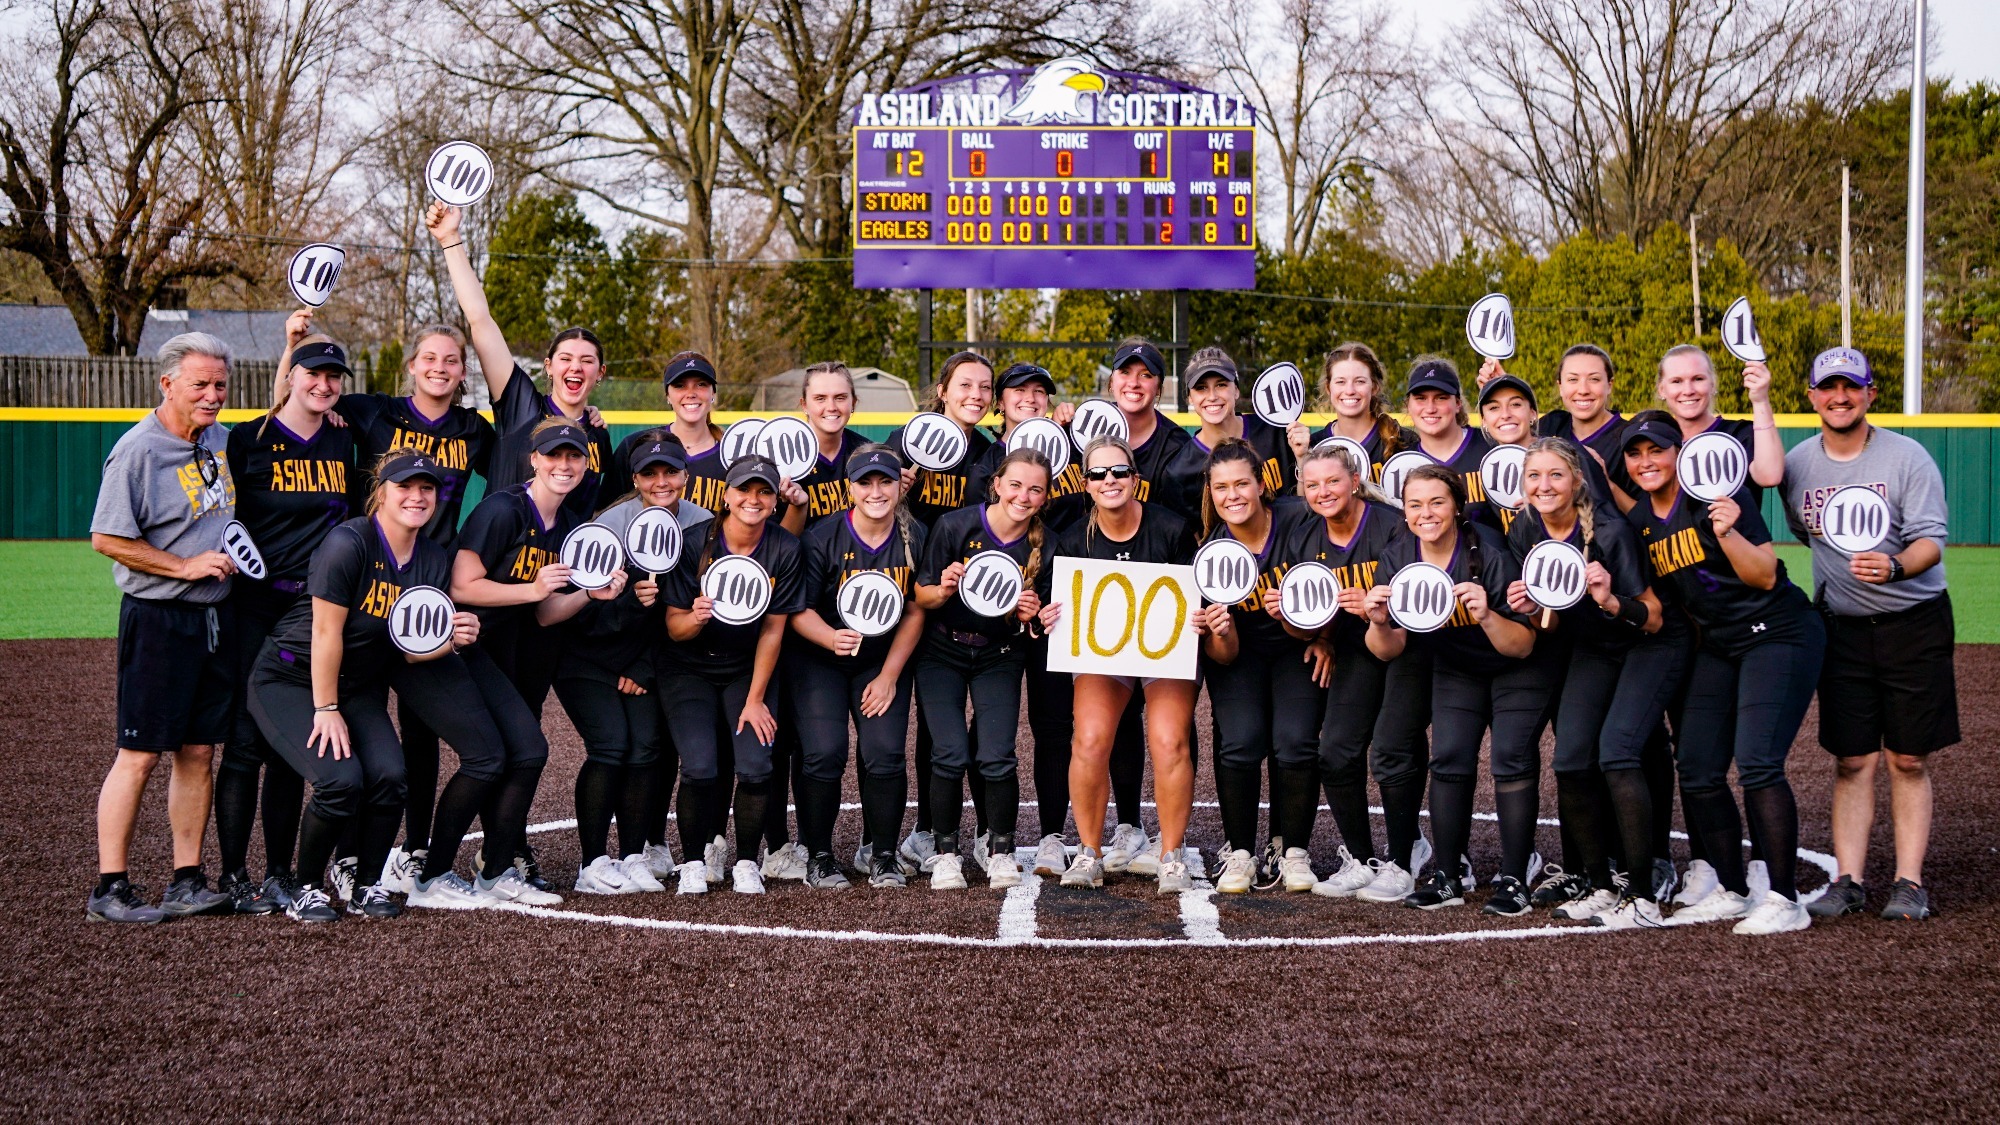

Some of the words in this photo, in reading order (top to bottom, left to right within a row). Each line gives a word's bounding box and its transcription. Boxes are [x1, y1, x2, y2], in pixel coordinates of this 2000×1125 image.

[858, 93, 1000, 126] ASHLAND
[1108, 93, 1251, 126] SOFTBALL
[873, 132, 889, 149] AT
[891, 132, 916, 149] BAT
[961, 132, 994, 149] BALL
[1040, 132, 1089, 149] STRIKE
[1133, 132, 1163, 149] OUT
[1208, 132, 1234, 150] H/E
[433, 154, 486, 197] 100
[896, 151, 924, 176] 12
[969, 151, 986, 177] 0
[1056, 151, 1073, 177] 0
[1212, 152, 1229, 176] H
[865, 192, 926, 211] STORM
[948, 181, 956, 194] 1
[964, 181, 973, 194] 2
[981, 181, 990, 194] 3
[1004, 181, 1013, 194] 4
[1021, 181, 1030, 194] 5
[1037, 181, 1046, 194] 6
[1061, 181, 1070, 194] 7
[1077, 181, 1086, 194] 8
[1094, 181, 1103, 194] 9
[1116, 181, 1131, 194] 10
[1143, 181, 1176, 194] RUNS
[1190, 181, 1217, 194] HITS
[1228, 181, 1251, 194] ERR
[1206, 195, 1217, 215] 7
[1234, 195, 1247, 216] 0
[861, 220, 928, 239] EAGLES
[1204, 222, 1217, 243] 8
[1820, 351, 1859, 367] ASHLAND
[1261, 374, 1301, 415] 100
[763, 430, 810, 466] 100
[909, 421, 959, 463] 100
[271, 459, 346, 493] ASHLAND
[1488, 460, 1525, 498] 10
[1687, 447, 1738, 487] 100
[1832, 502, 1883, 538] 100
[226, 530, 262, 575] 100
[570, 537, 617, 577] 100
[633, 521, 676, 560] 100
[965, 565, 1017, 609] 100
[1203, 555, 1250, 590] 100
[1529, 555, 1579, 596] 100
[713, 570, 762, 610] 100
[844, 585, 895, 626] 100
[1287, 576, 1334, 614] 100
[1396, 578, 1447, 617] 100
[398, 603, 448, 638] 100
[1071, 569, 1187, 660] 100
